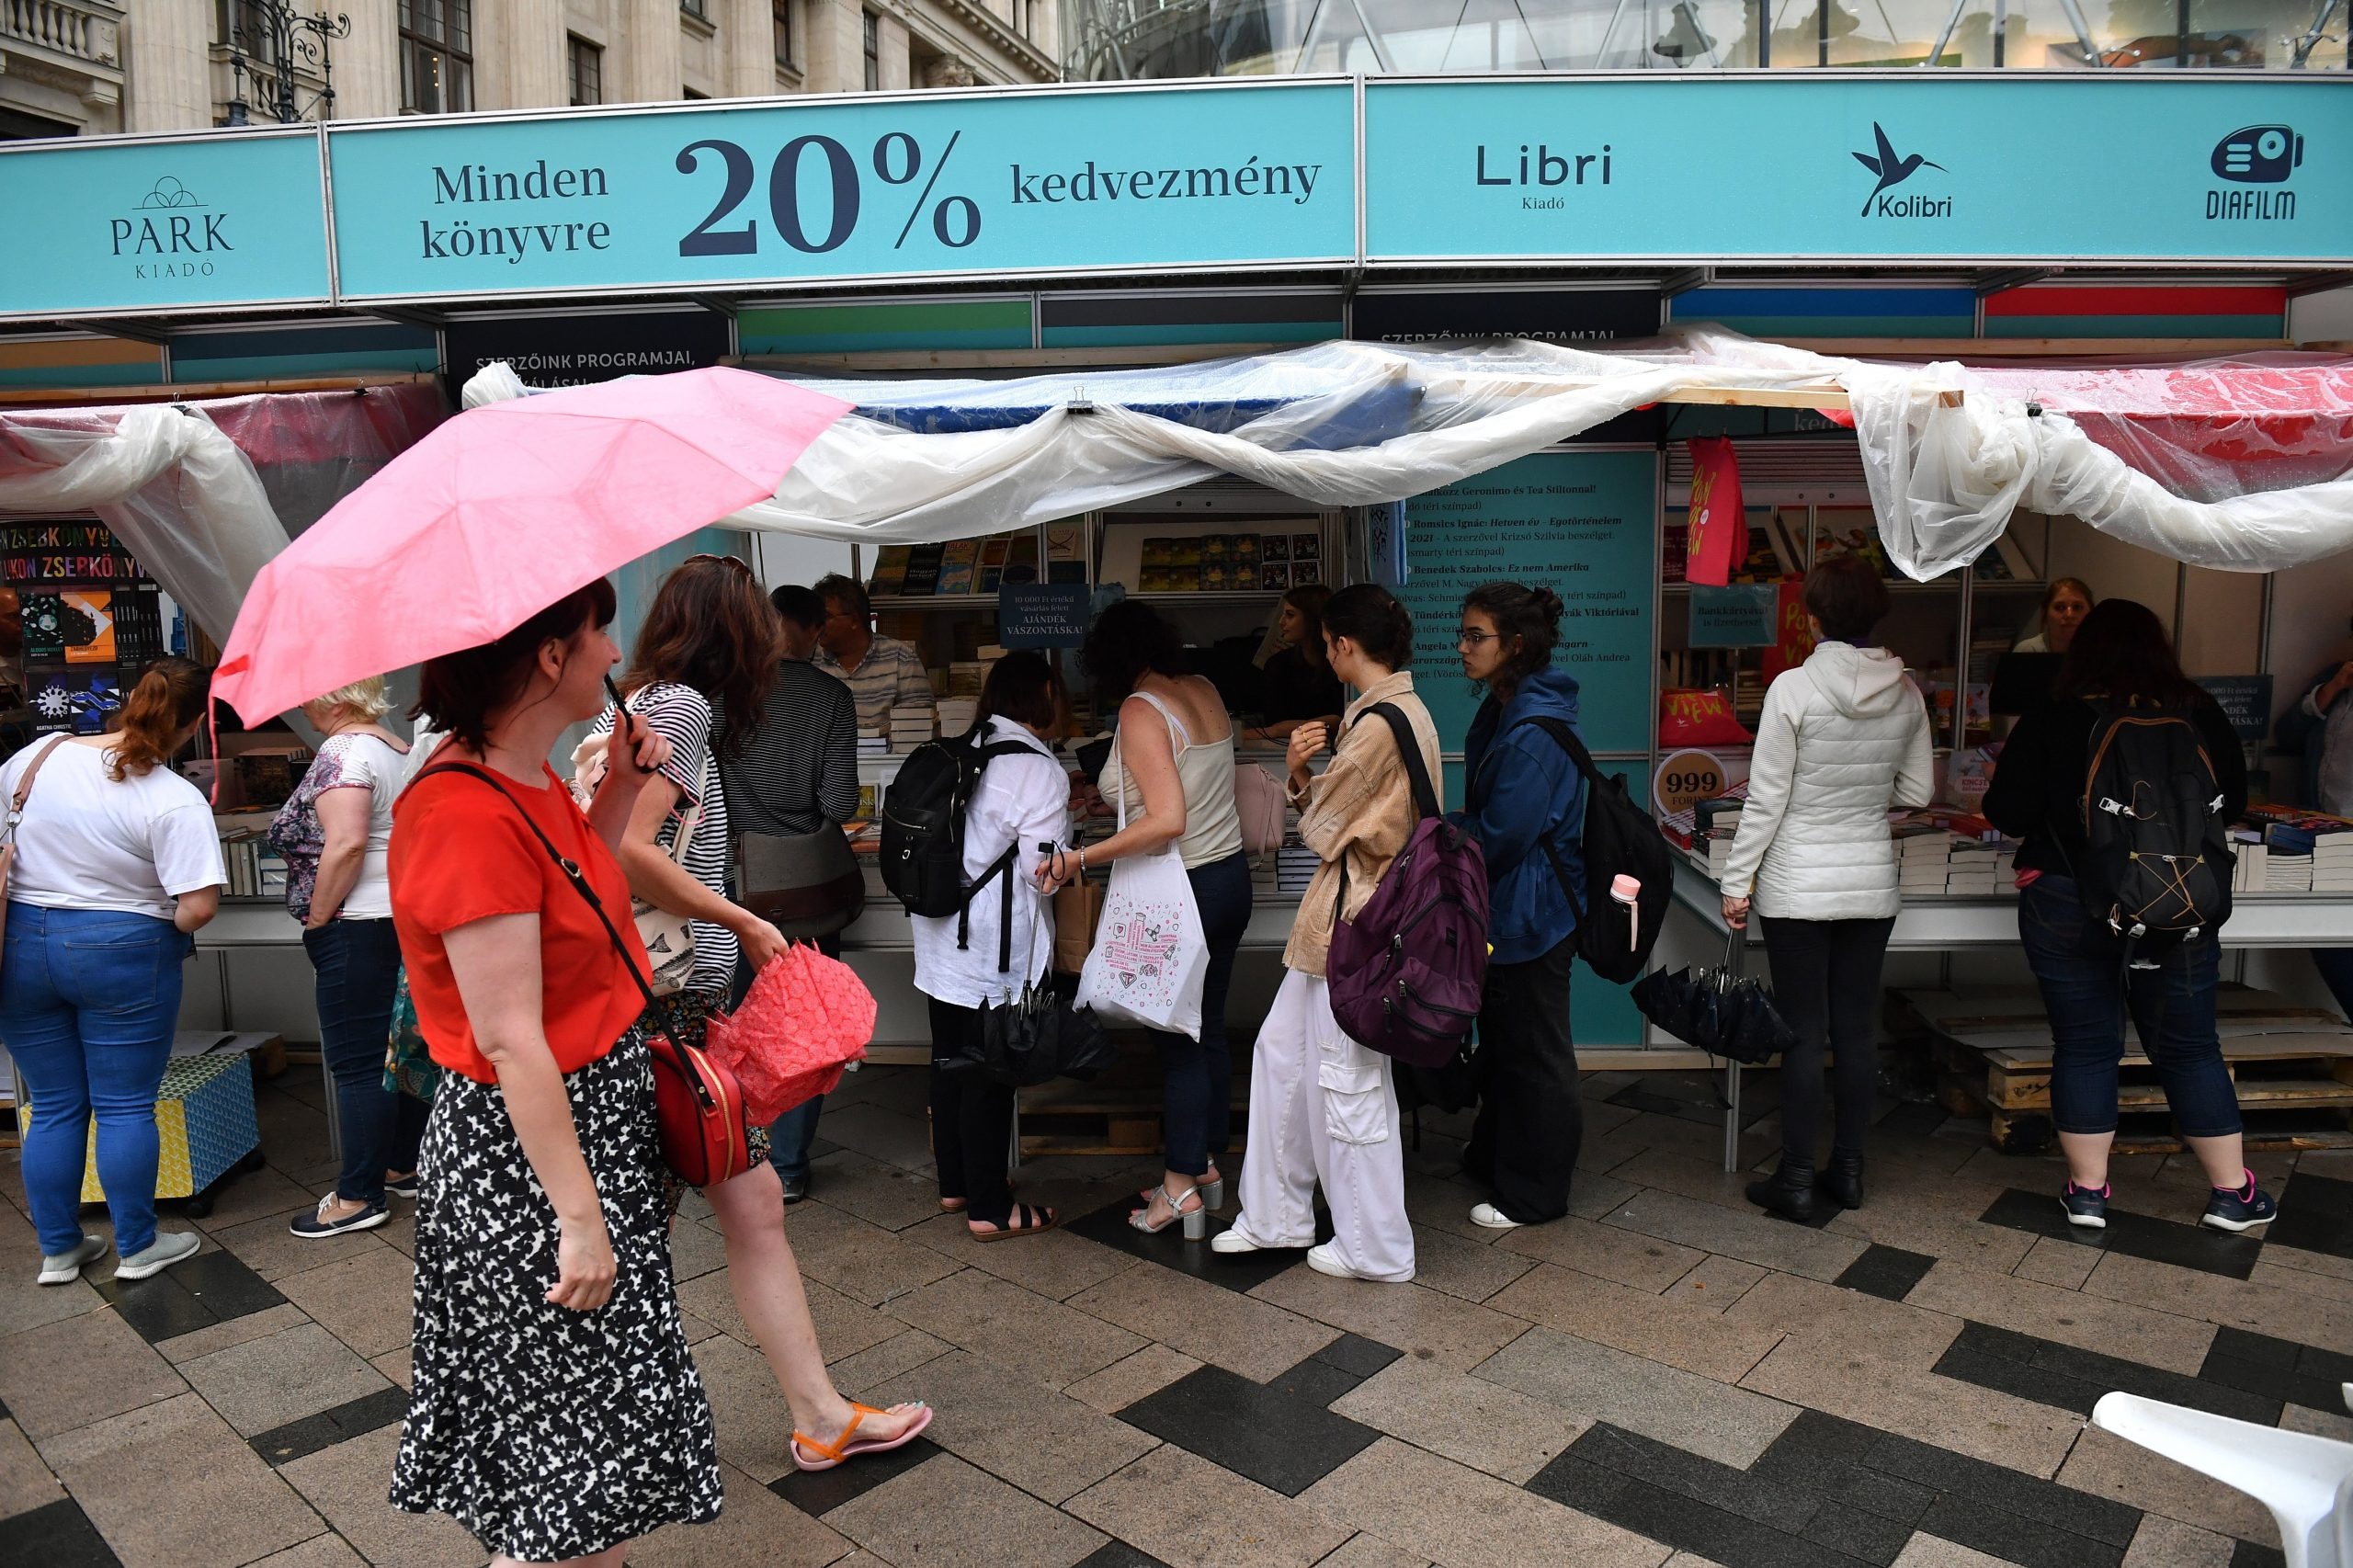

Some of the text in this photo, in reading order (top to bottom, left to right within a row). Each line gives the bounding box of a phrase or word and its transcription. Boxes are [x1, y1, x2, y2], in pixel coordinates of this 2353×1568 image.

[1477, 144, 1611, 186] Libri
[431, 159, 609, 205] Minden
[1009, 155, 1323, 205] kedvezmény
[675, 130, 982, 257] 20%
[1522, 197, 1564, 210] Kiadó
[1877, 194, 1952, 218] Kolibri
[2206, 190, 2296, 220] DIAFILM
[110, 212, 234, 256] PARK
[420, 220, 611, 265] könyvre
[135, 258, 214, 279] KIADÓ
[577, 350, 696, 369] PROGRAMJAI,
[1462, 486, 1510, 495] Geronimo
[1513, 485, 1525, 494] és
[1526, 484, 1544, 494] Tea
[1546, 483, 1597, 494] Stiltonnal!
[1423, 501, 1440, 511] téri
[1442, 500, 1482, 512] színpad)
[1414, 518, 1455, 528] Romsics
[1458, 517, 1488, 529] Ignác:
[1490, 517, 1525, 528] Hetven
[1528, 516, 1540, 527] év
[1550, 515, 1622, 528] Egotörténelem
[1443, 533, 1450, 542] A
[1453, 531, 1498, 542] szerzővel
[1501, 530, 1531, 541] Krizsó
[1534, 530, 1565, 540] Szilvia
[1446, 547, 1462, 557] téri
[1465, 546, 1505, 559] színpad)
[1414, 565, 1457, 574] Benedek
[1460, 564, 1506, 574] Szabolcs:
[1507, 563, 1519, 573] Ez
[1521, 564, 1543, 573] nem
[1546, 562, 1589, 572] Amerika
[1567, 591, 1585, 601] téri
[1586, 590, 1627, 601] színpad)
[1022, 613, 1067, 623] AJÁNDÉK
[1585, 608, 1640, 617] Viktóriával
[1006, 624, 1084, 635] VÁSZONTÁSKA!
[1423, 624, 1439, 634] téri
[1414, 642, 1448, 652] Angela
[1573, 653, 1593, 663] Oláh
[1596, 653, 1630, 662] Andrea
[1666, 771, 1718, 793] 999
